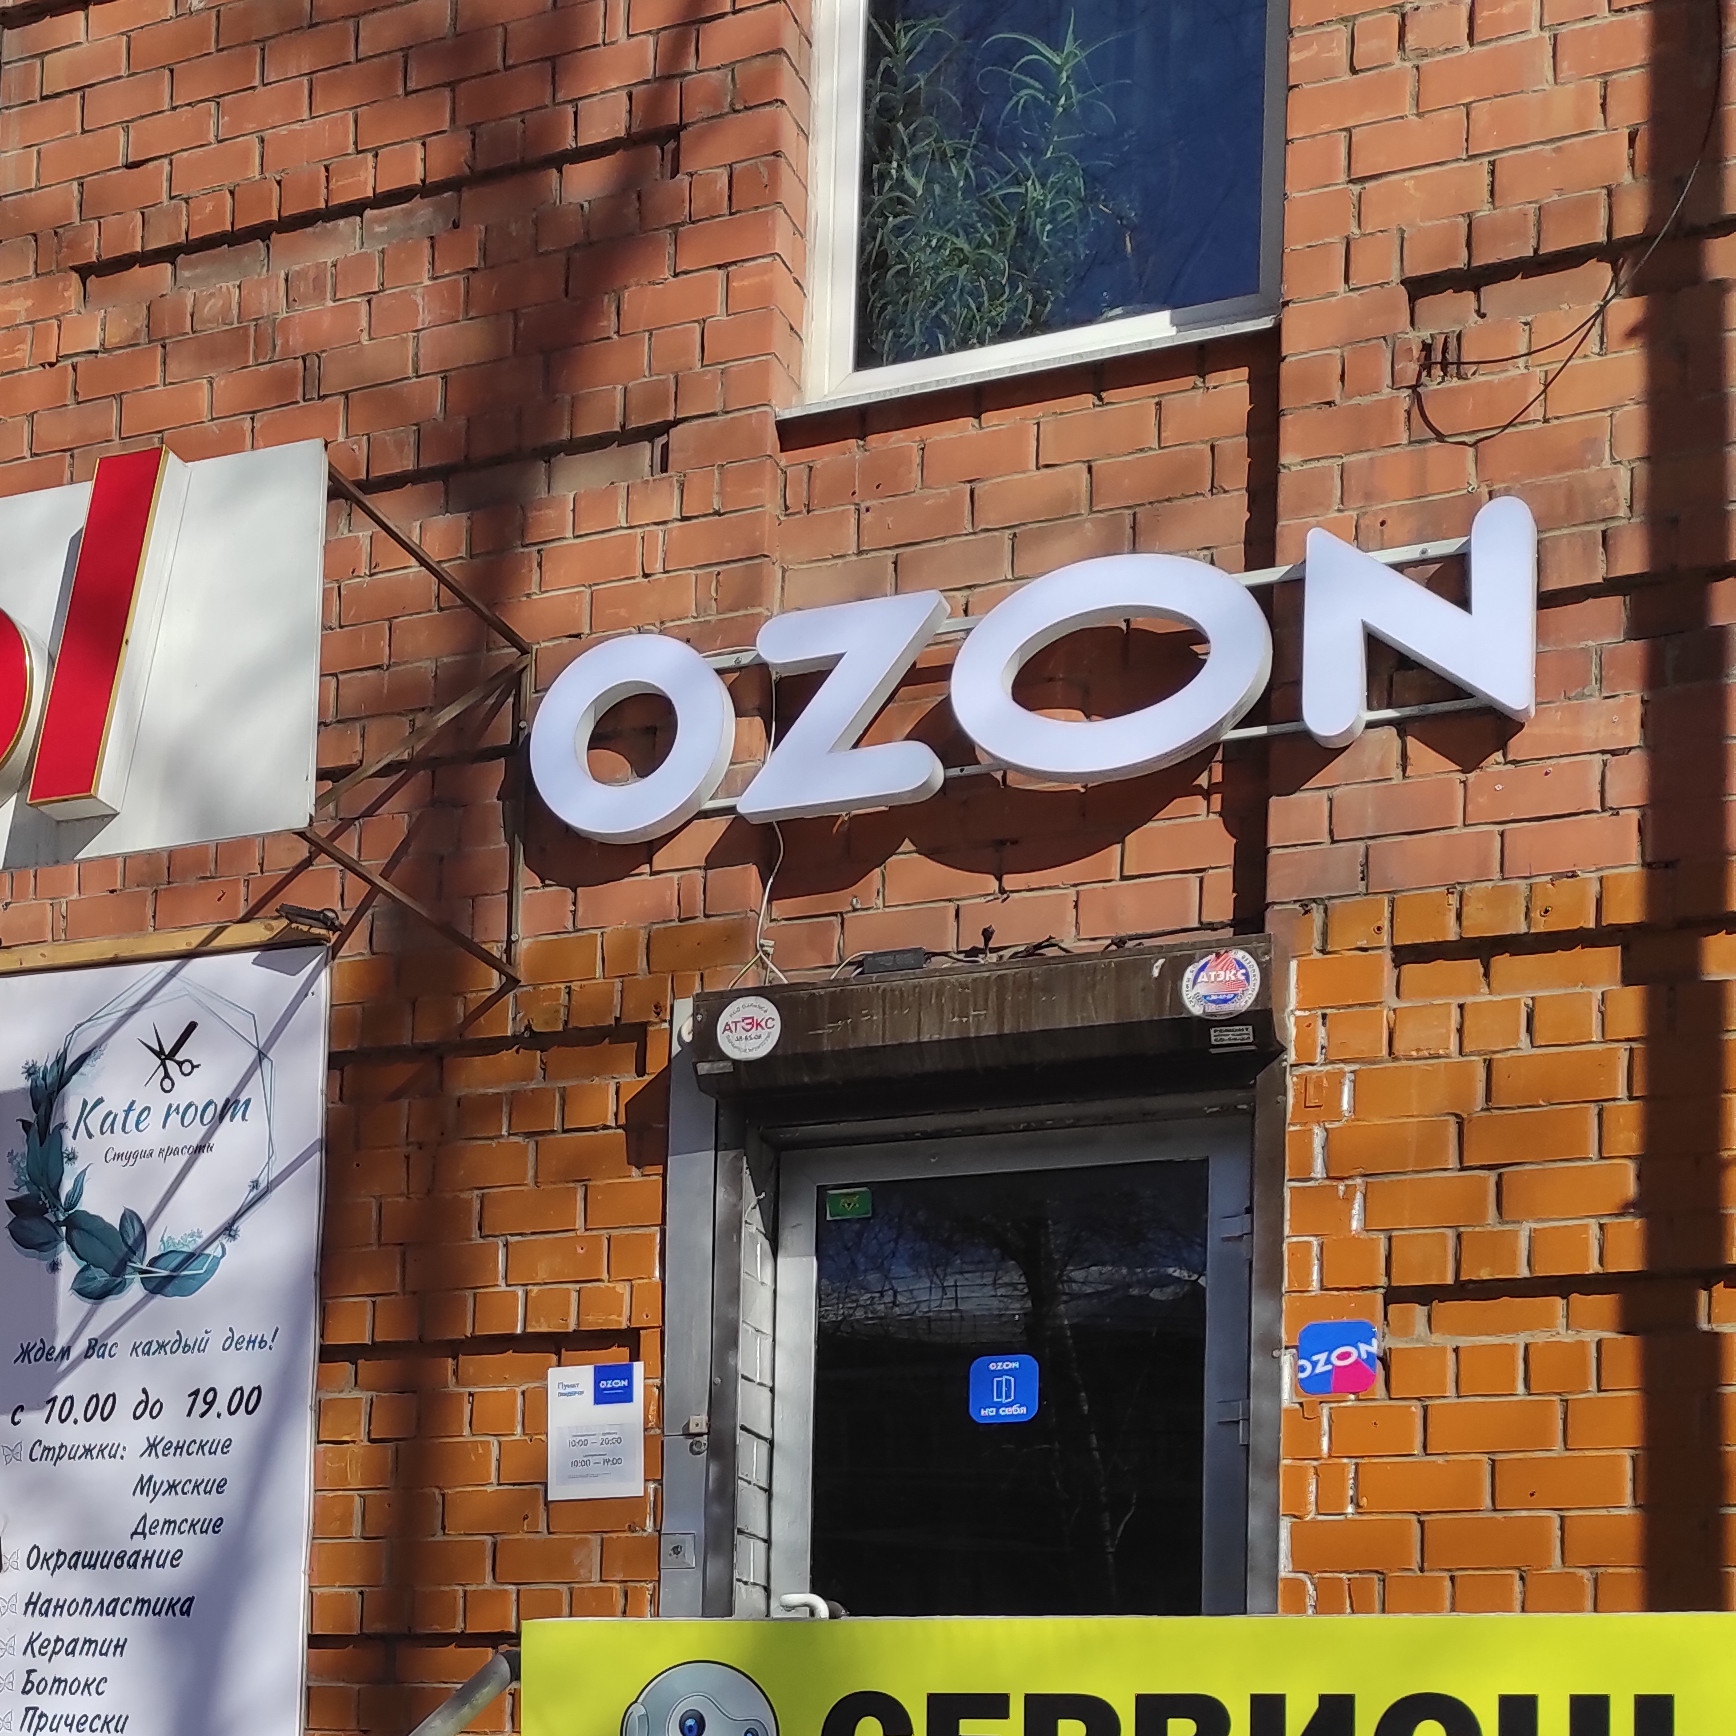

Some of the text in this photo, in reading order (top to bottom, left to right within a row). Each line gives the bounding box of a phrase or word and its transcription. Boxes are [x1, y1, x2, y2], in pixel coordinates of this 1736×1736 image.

[530, 495, 1538, 845] OZON
[721, 1016, 775, 1035] АТЭКС
[72, 1096, 252, 1141] Kate room
[104, 1147, 154, 1167] Студия
[13, 1326, 280, 1366] Ждем Вас каждый день!
[1298, 1337, 1378, 1379] OZON
[989, 1361, 1020, 1370] OZON
[599, 1379, 628, 1388] OZON
[10, 1384, 264, 1427] с 10.00 до 19.00
[980, 1404, 1027, 1416] на себя
[28, 1435, 233, 1466] Стрижки: Женские
[132, 1473, 228, 1503] Мужские
[130, 1512, 224, 1541] Детские
[26, 1545, 184, 1576] Окрашивание
[22, 1591, 196, 1619] Нанопластика
[21, 1630, 128, 1663] Кератин
[20, 1668, 108, 1697] Ботокс
